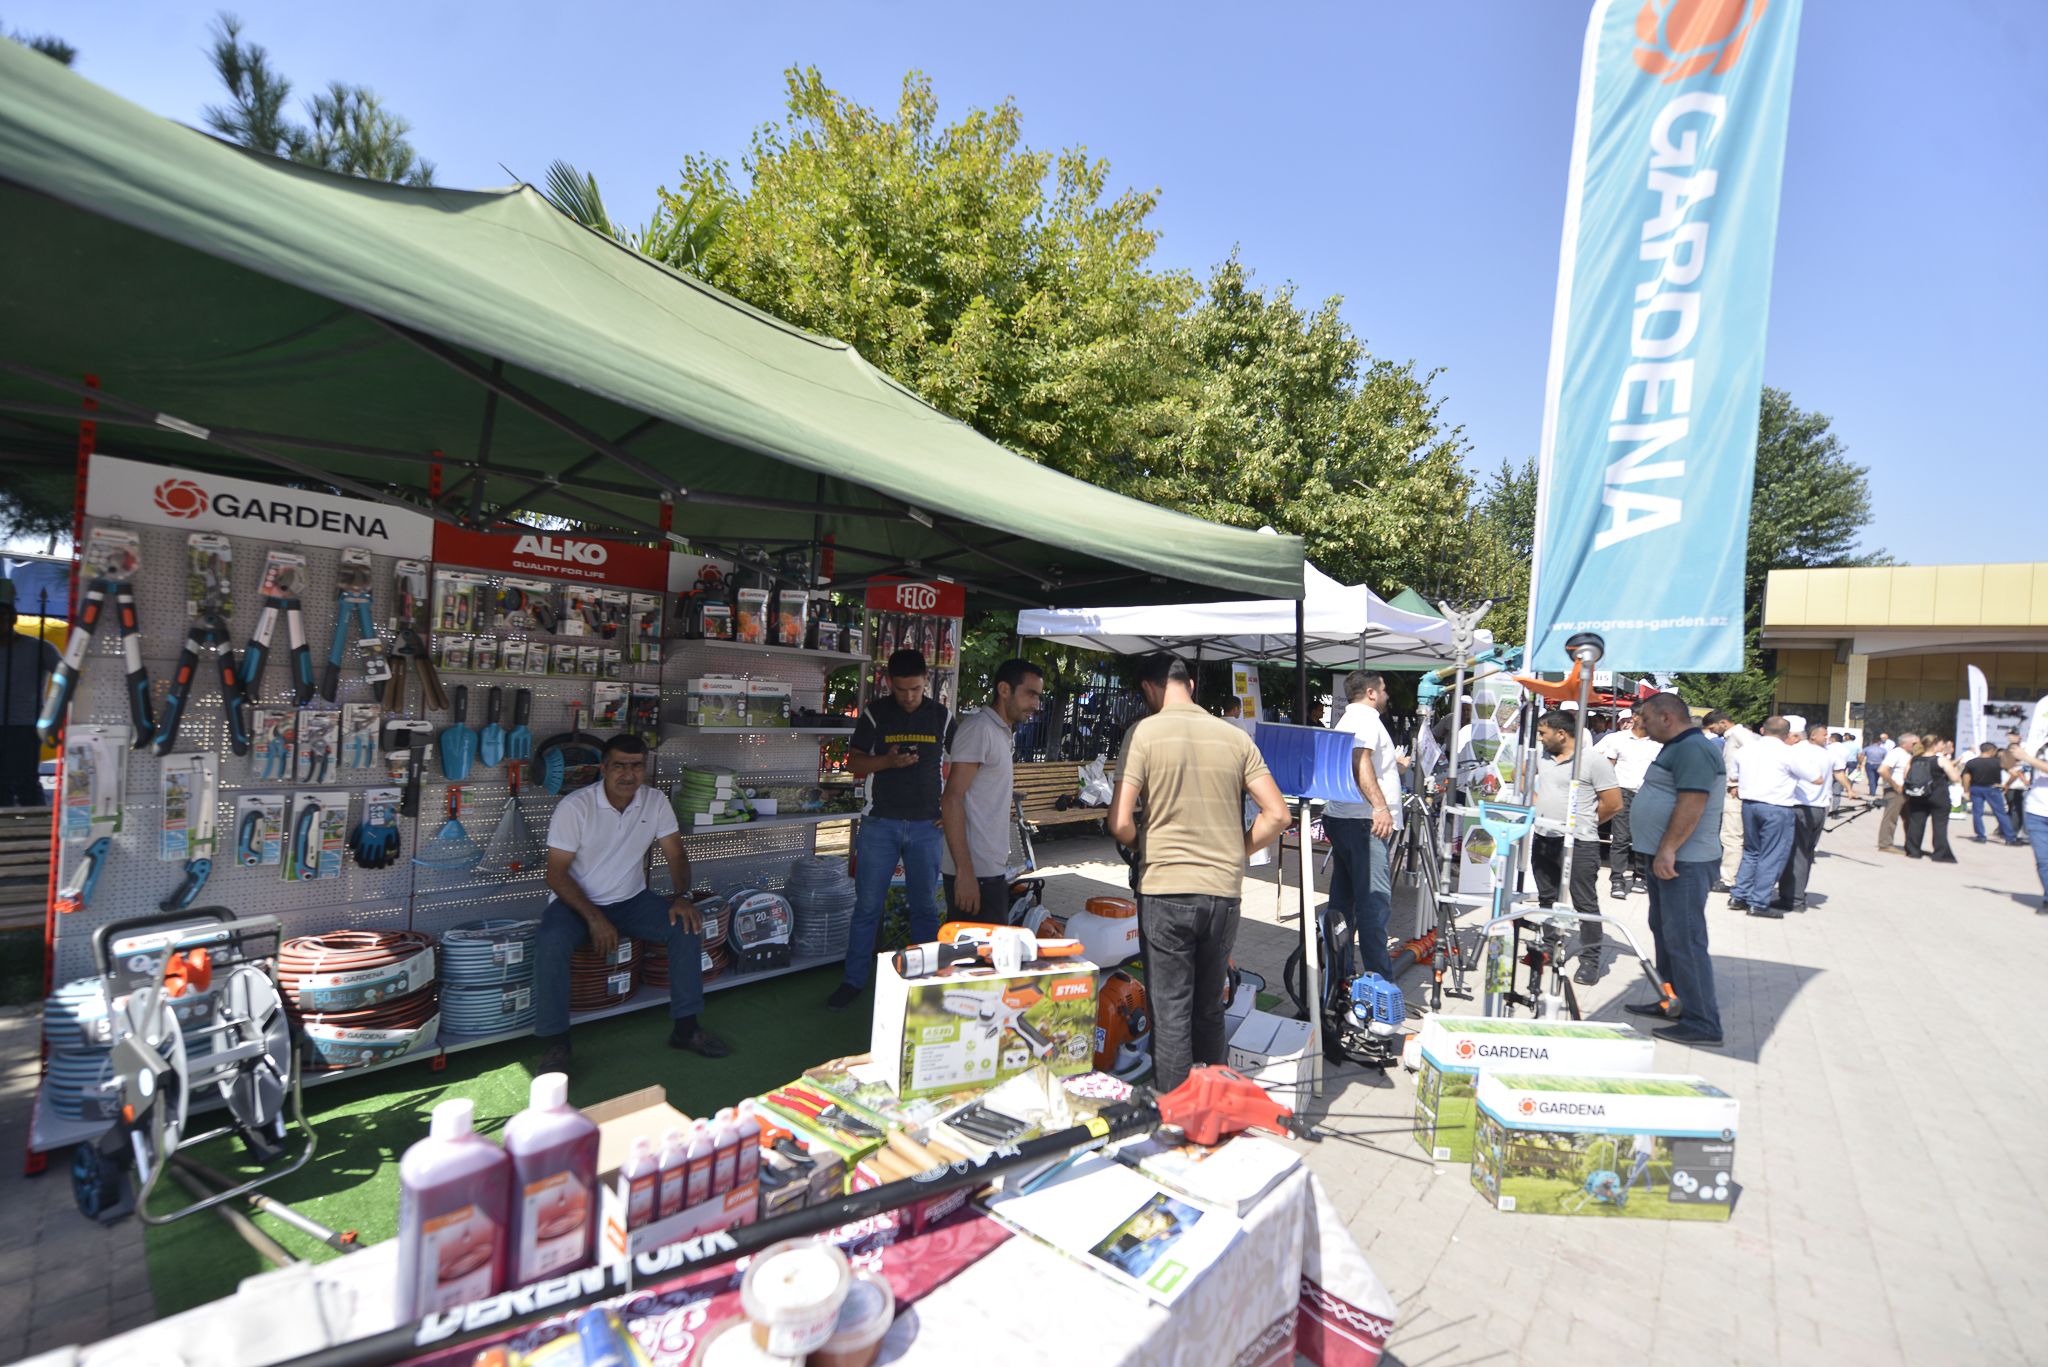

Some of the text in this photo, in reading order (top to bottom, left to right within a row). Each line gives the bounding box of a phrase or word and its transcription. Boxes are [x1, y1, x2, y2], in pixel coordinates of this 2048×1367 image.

[1594, 91, 1728, 552] GARDENA
[211, 493, 390, 541] GARDENA
[512, 535, 608, 566] AL-KO
[512, 560, 606, 579] QUALITY FOR LIFE
[896, 582, 937, 611] FELCO
[343, 971, 385, 984] GARDENA
[1056, 983, 1089, 997] STIHL
[347, 1032, 388, 1041] GARDENA
[1478, 1044, 1550, 1060] GARDENA
[1539, 1101, 1607, 1117] GARDENA
